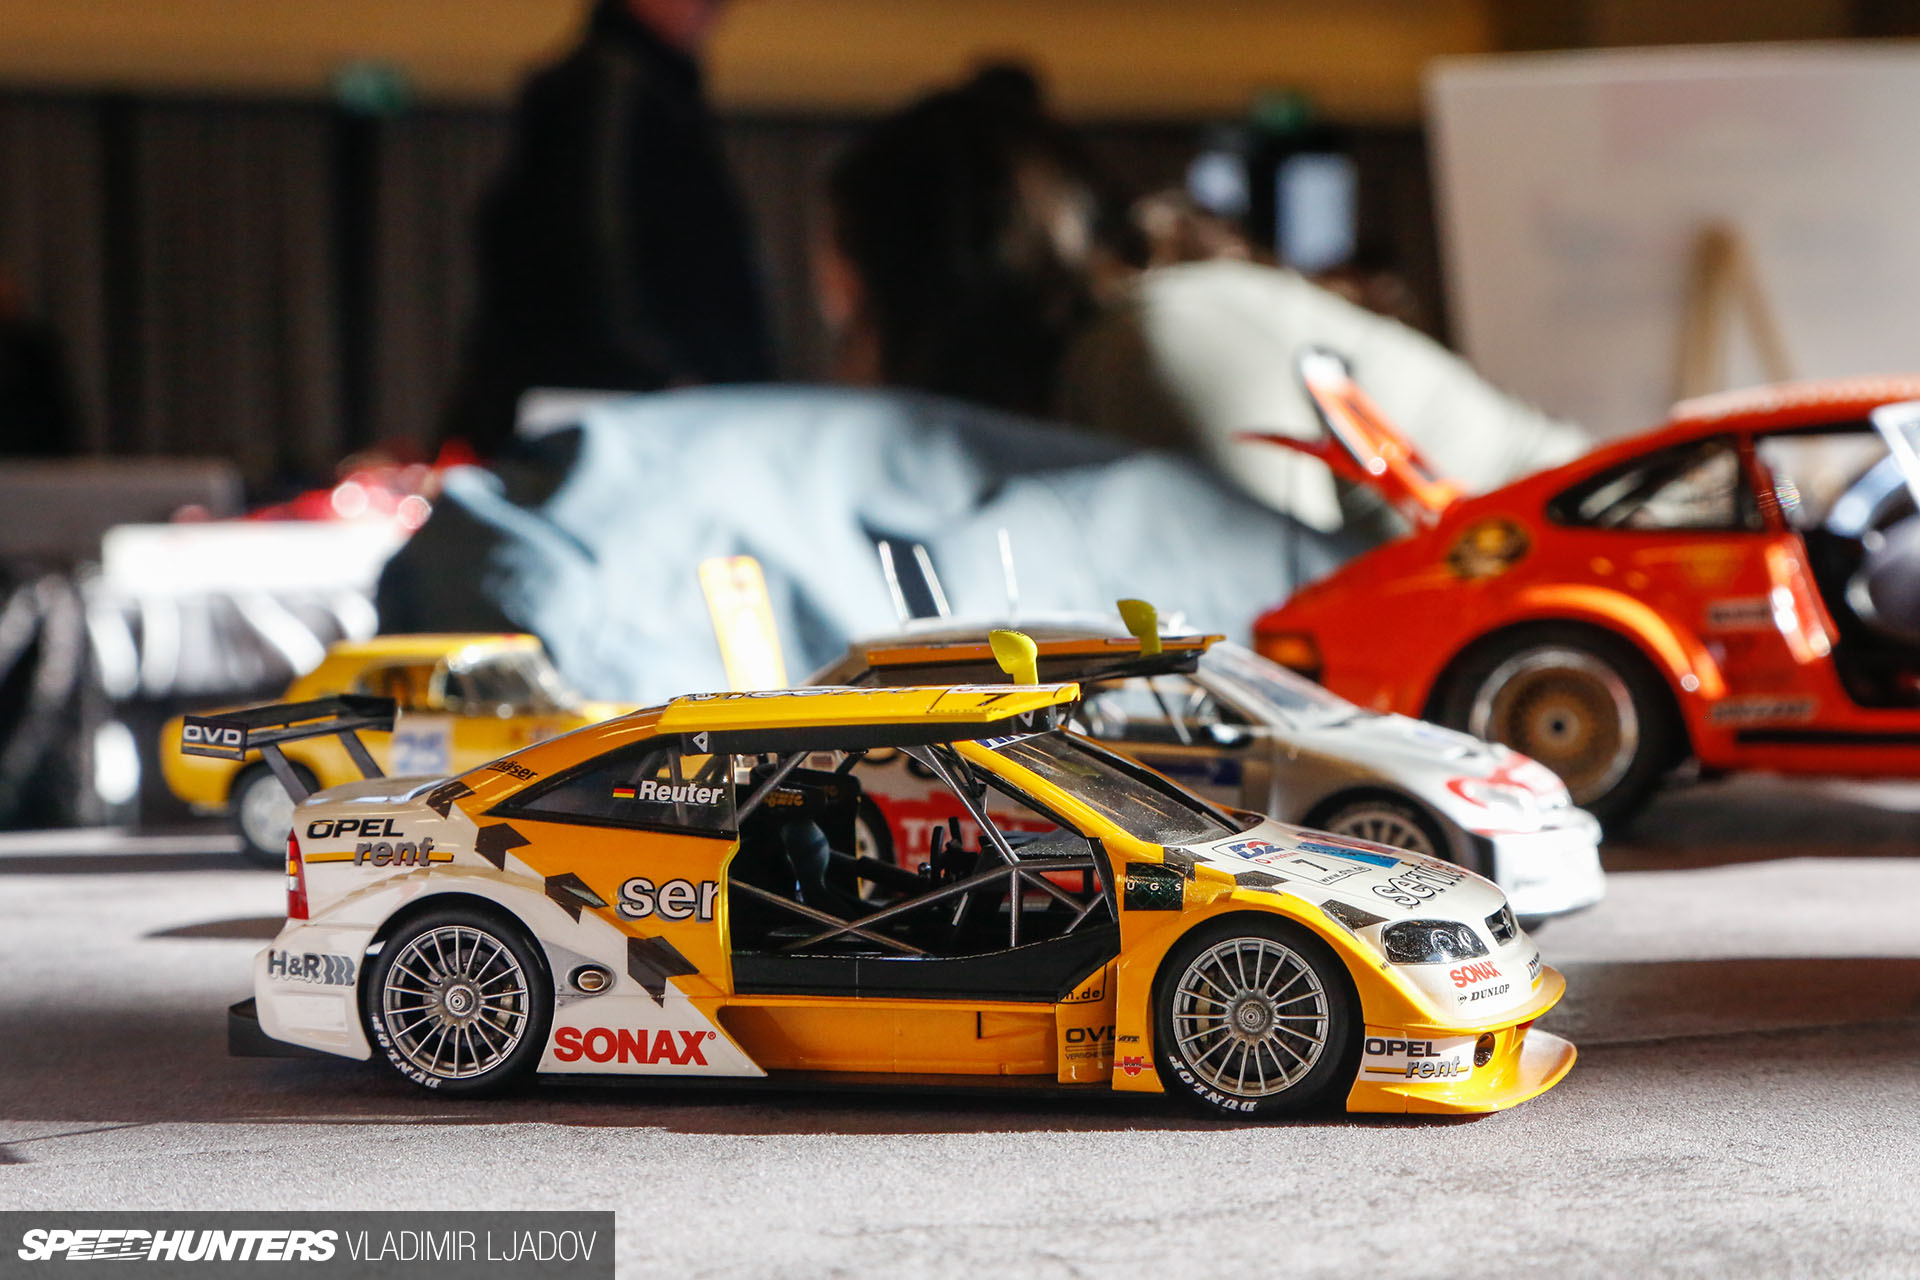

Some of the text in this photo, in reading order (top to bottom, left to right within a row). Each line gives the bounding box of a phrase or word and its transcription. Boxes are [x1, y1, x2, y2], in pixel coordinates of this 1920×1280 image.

[183, 725, 242, 745] OVD
[638, 780, 724, 804] Reuter
[307, 819, 404, 839] OPEL
[354, 837, 434, 867] rent
[268, 950, 320, 979] H&R
[1449, 960, 1502, 988] SONAX
[1470, 983, 1510, 1001] DUNLOP
[1365, 1038, 1441, 1057] OPEL
[1405, 1056, 1461, 1078] rent
[1168, 1055, 1257, 1112] DUNLOP
